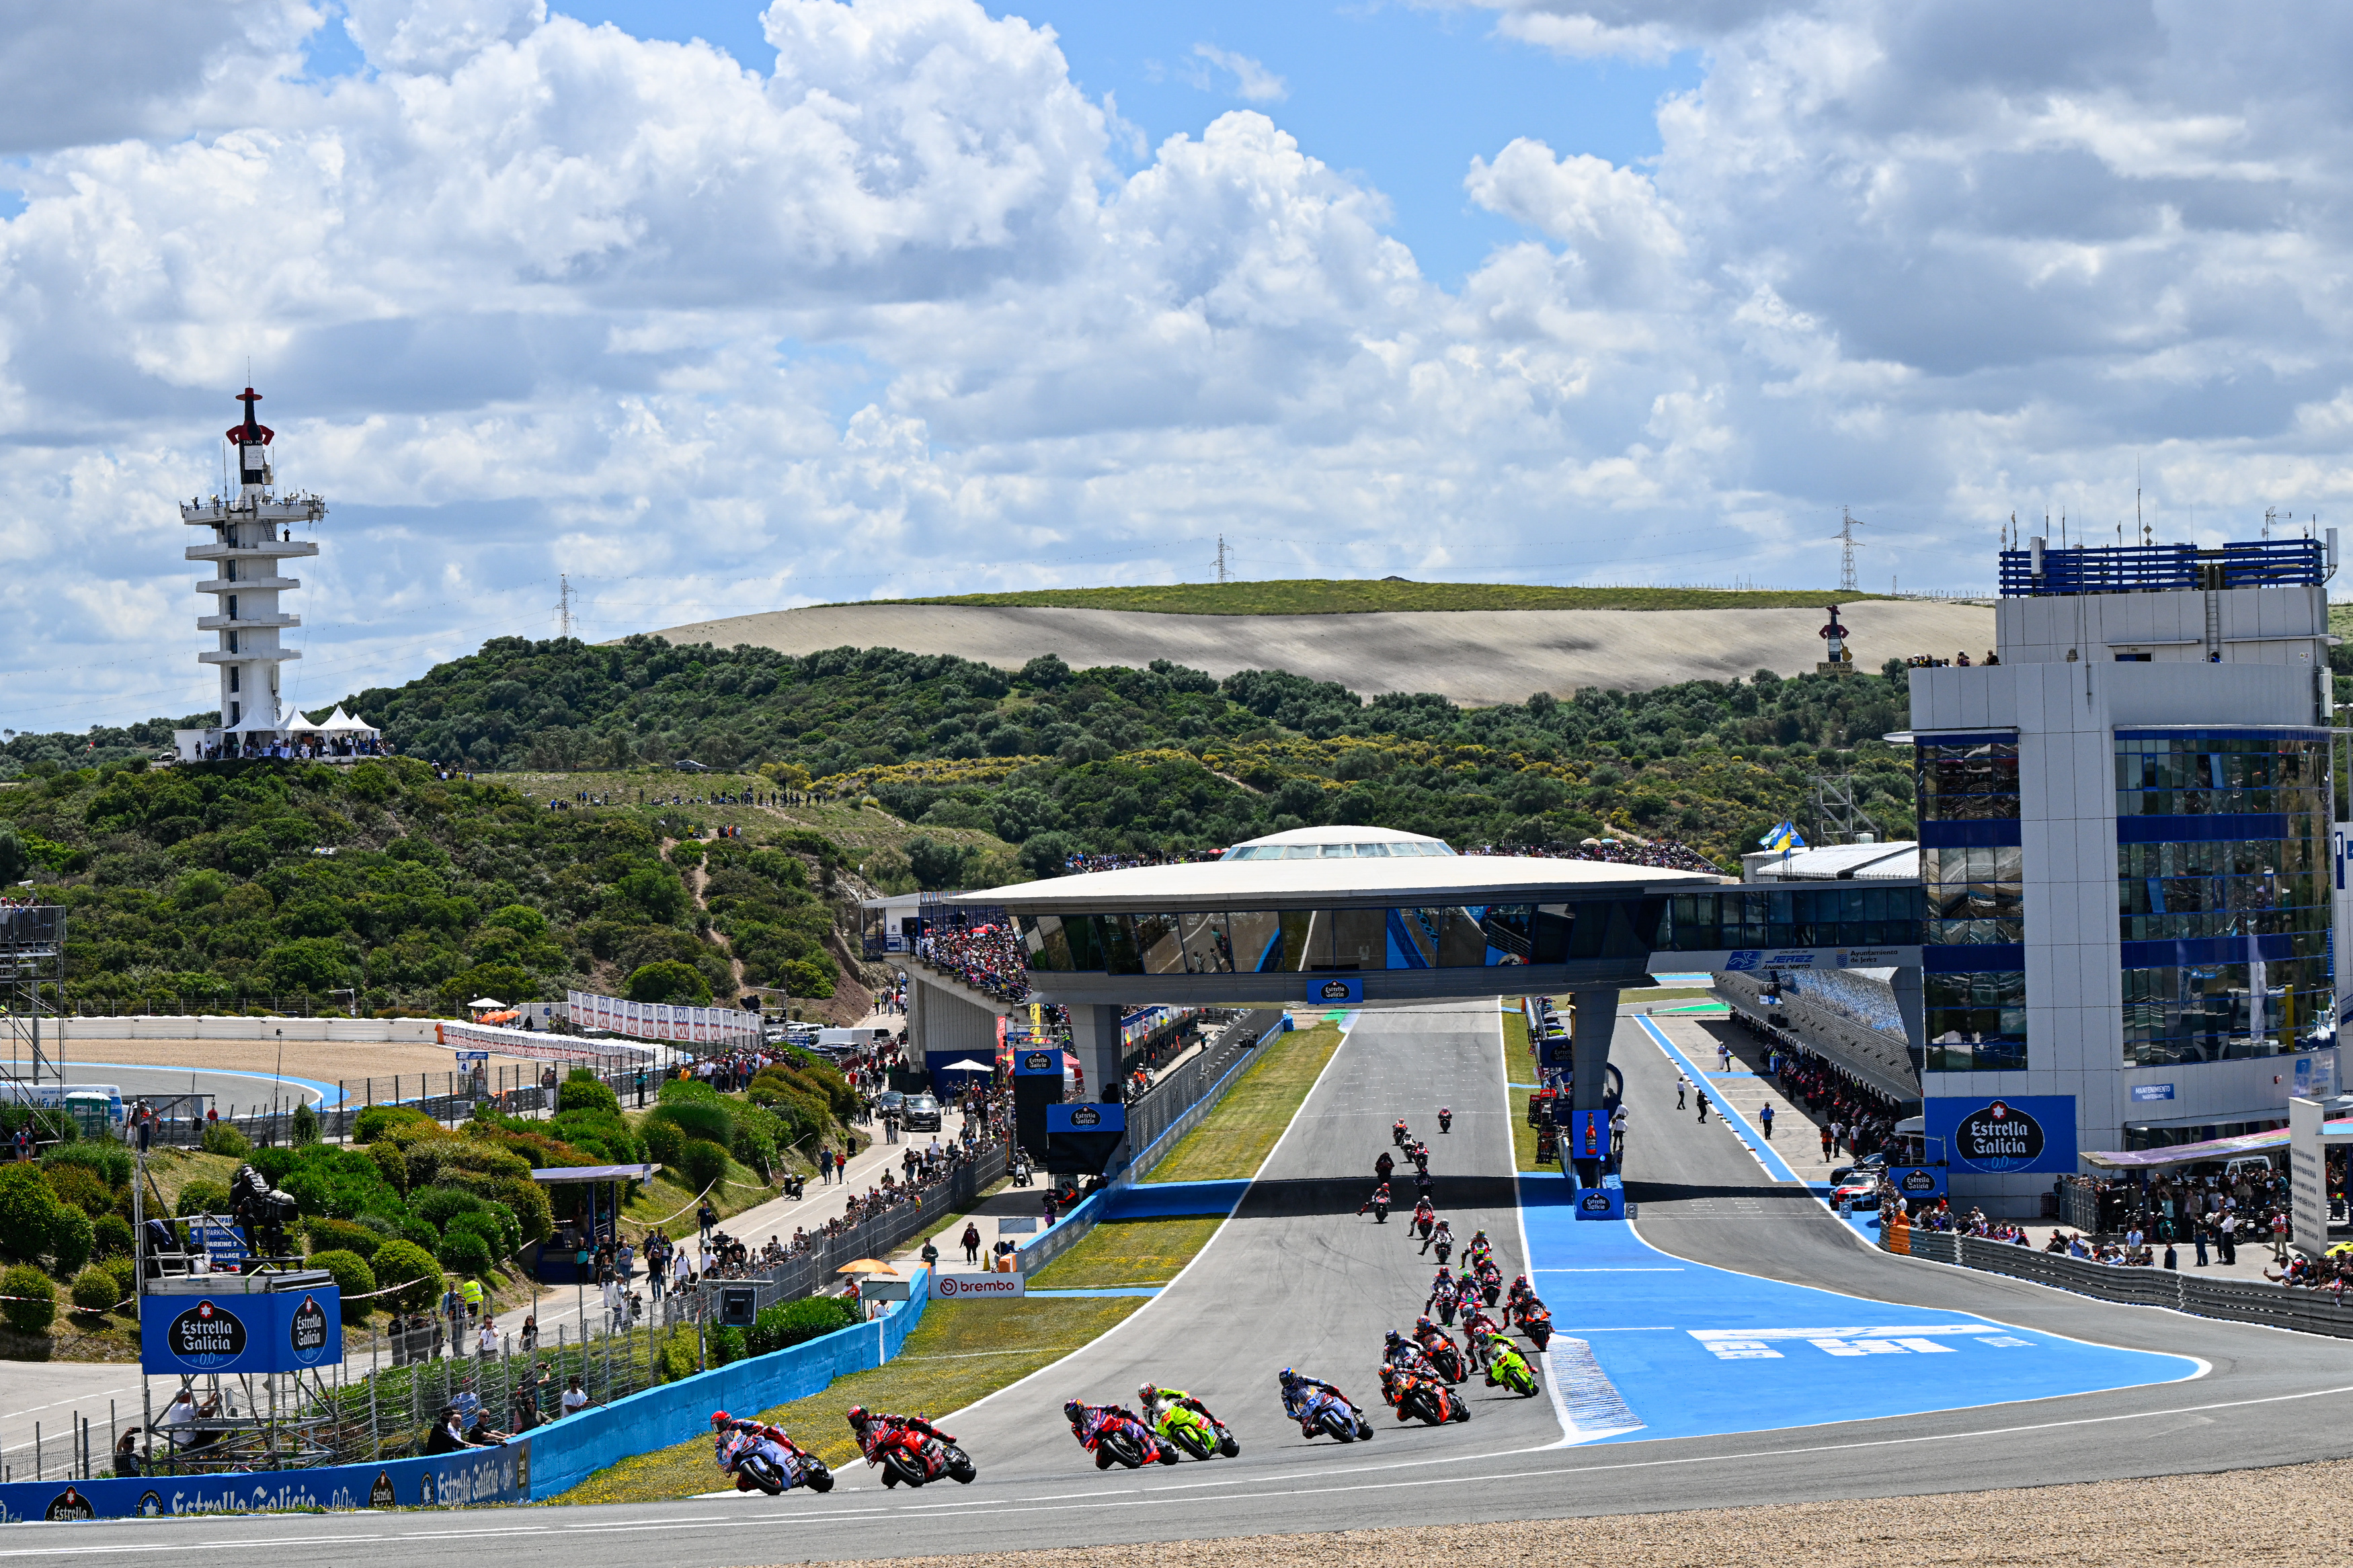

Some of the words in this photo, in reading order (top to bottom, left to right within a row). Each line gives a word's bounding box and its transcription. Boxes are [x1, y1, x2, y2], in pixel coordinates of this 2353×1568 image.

[1765, 955, 1815, 963] JEREZ
[1850, 950, 1898, 958] Ayuntamiento
[582, 995, 594, 1009] LIQUI
[598, 997, 610, 1012] LIQUI
[583, 1009, 594, 1025] MOLY
[627, 1003, 638, 1018] LIQUI
[642, 1005, 653, 1021] LIQUI
[657, 1006, 668, 1022] LIQUI
[673, 1008, 688, 1022] LIQUI
[693, 1009, 705, 1024] LIQUI
[598, 1013, 610, 1028] MOLY
[612, 1016, 623, 1031] MOLY
[627, 1019, 638, 1034] MOLY
[642, 1022, 653, 1036] MOLY
[657, 1023, 669, 1038] MOLY
[674, 1024, 689, 1038] MOLY
[694, 1026, 707, 1040] MOLY
[461, 1063, 467, 1071] 4
[2136, 1085, 2170, 1094] MANTENIMIENTO
[1970, 1121, 2028, 1137] Estrella
[1974, 1138, 2027, 1154] Galicia
[1991, 1155, 2009, 1169] 0,0
[960, 1280, 1014, 1292] brembo
[181, 1320, 233, 1335] Estrella
[296, 1314, 321, 1330] Estrella
[184, 1335, 231, 1350] Galicia
[298, 1329, 320, 1346] Galicia
[200, 1352, 215, 1365] 0,0
[438, 1469, 471, 1505] Estrella
[472, 1459, 498, 1500] Galicia
[373, 1488, 391, 1501] Estrella
[54, 1505, 87, 1521] Estrella
